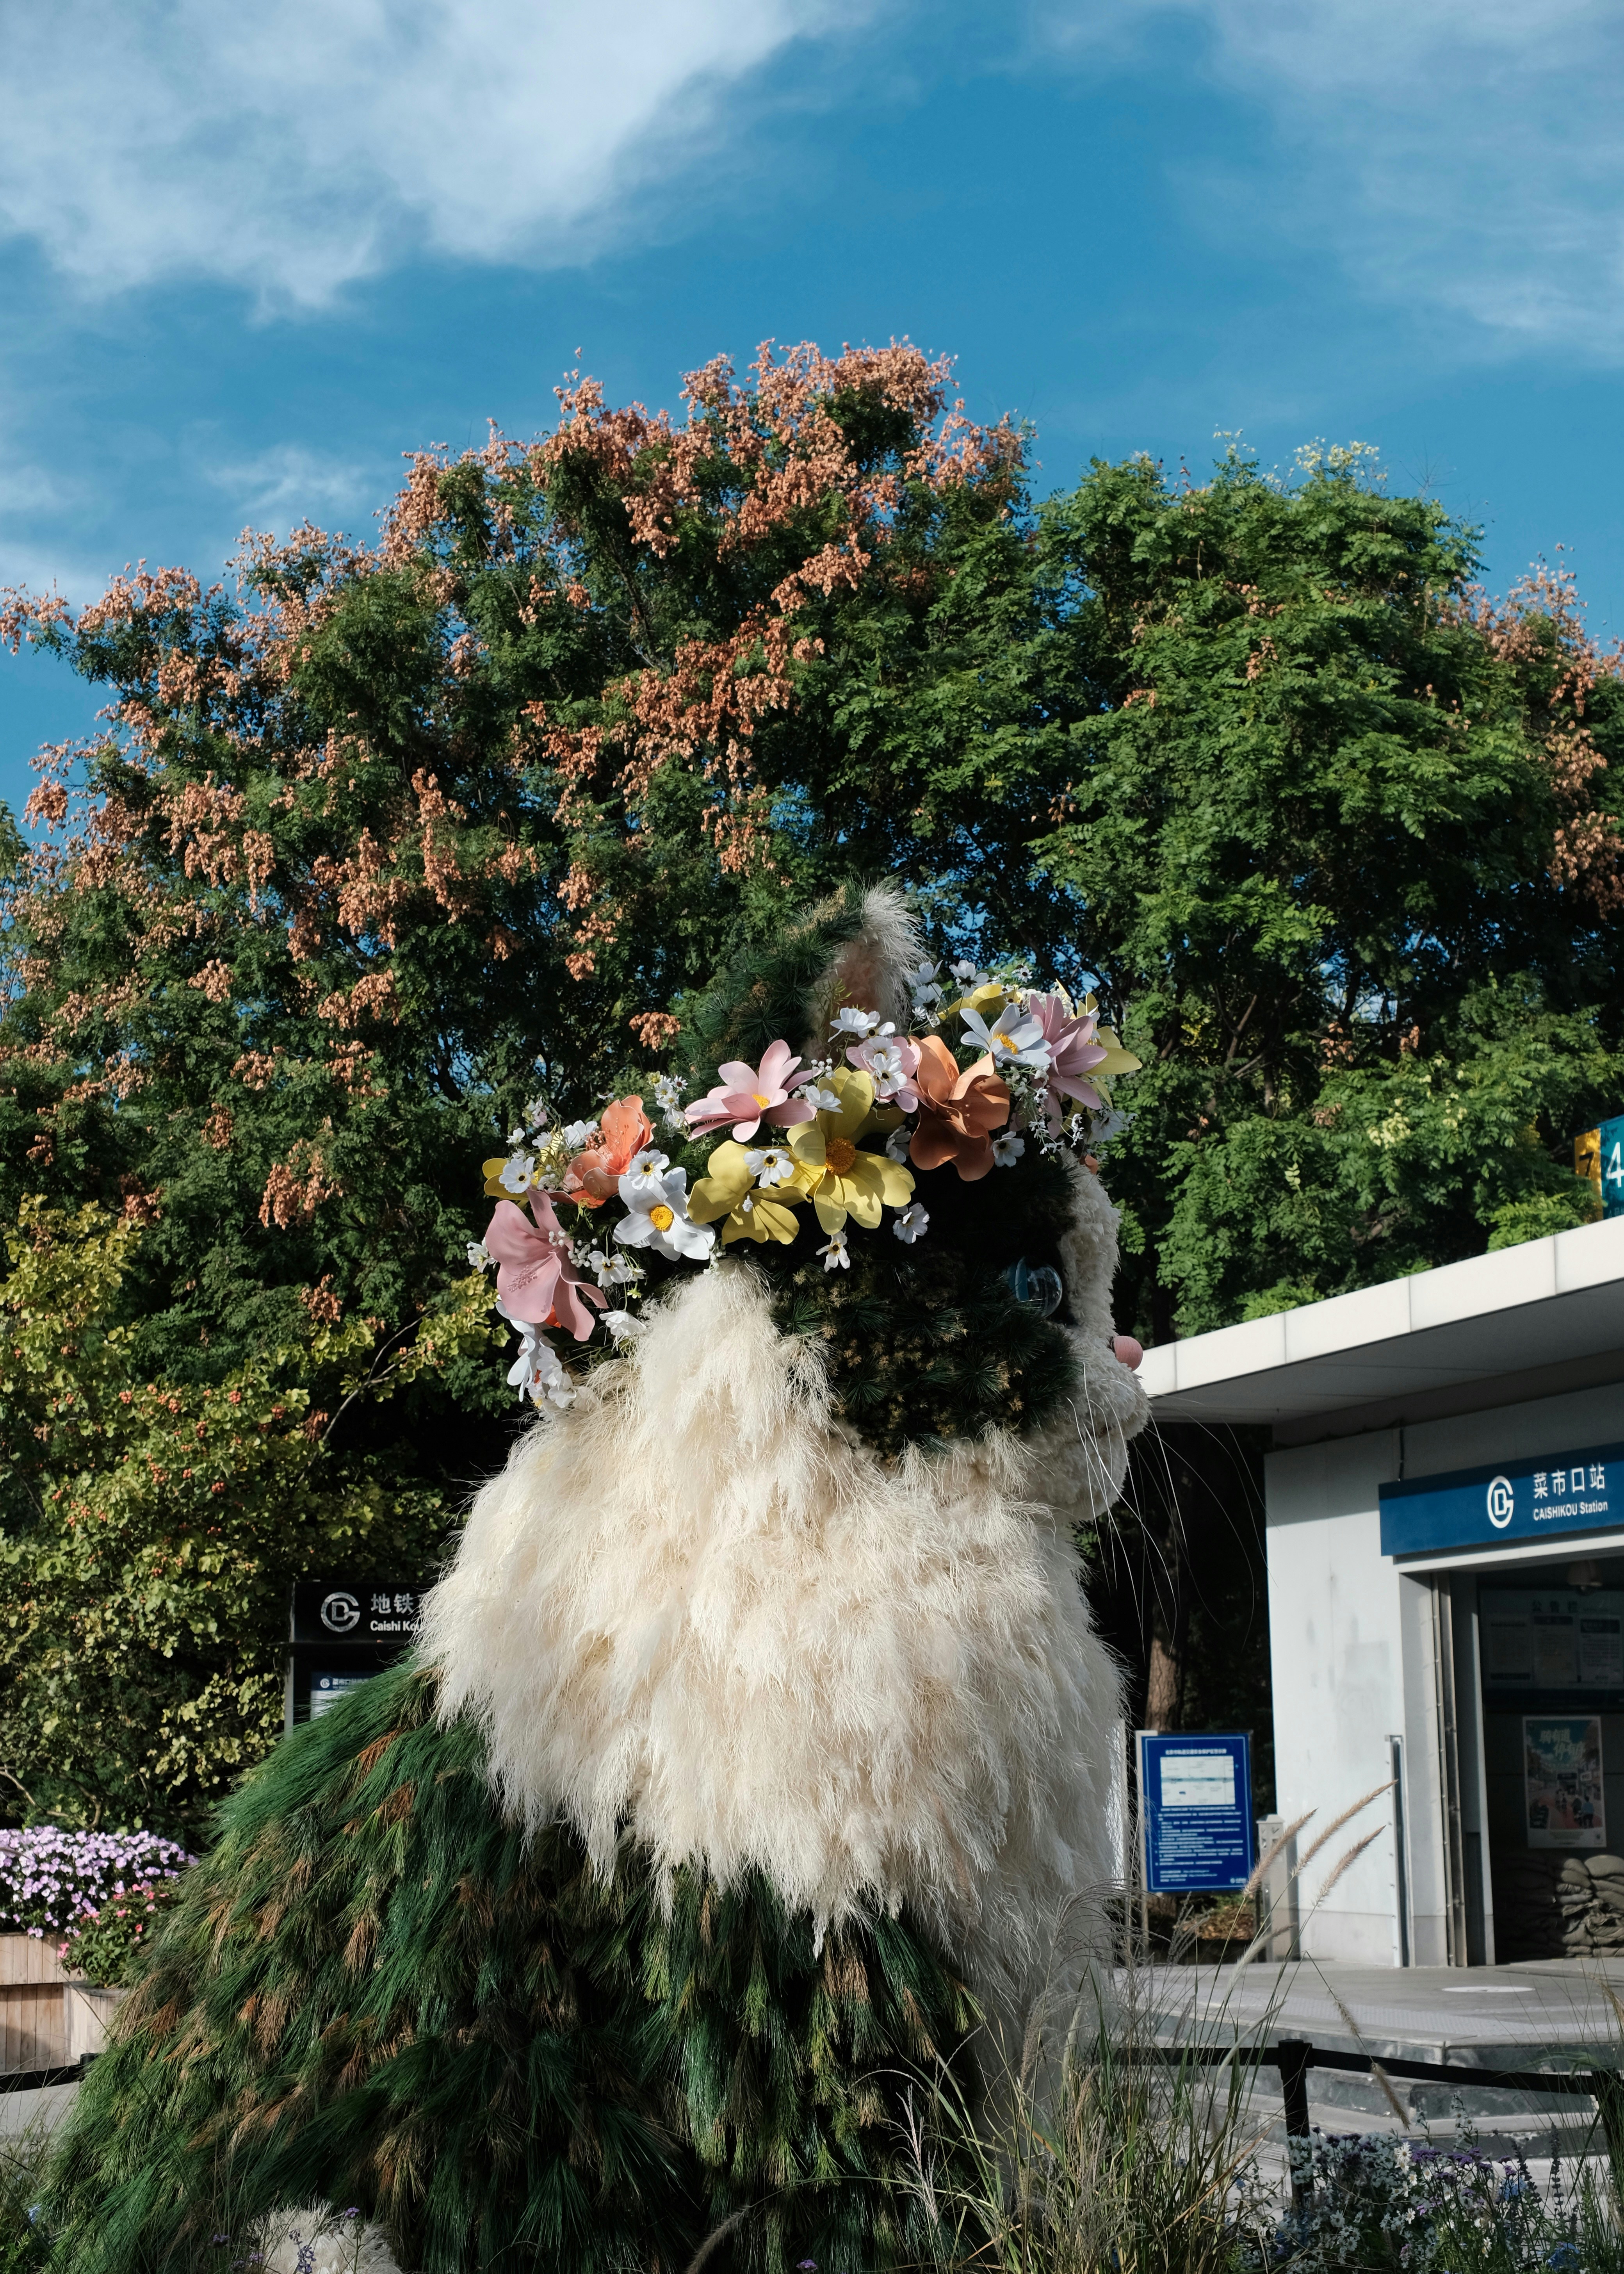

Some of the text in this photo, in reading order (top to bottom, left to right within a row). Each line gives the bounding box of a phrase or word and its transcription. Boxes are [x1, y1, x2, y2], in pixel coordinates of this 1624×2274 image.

[1606, 1142, 1624, 1188] 4
[1533, 1462, 1605, 1499] 菜市口站
[1534, 1500, 1608, 1521] CAISHIKOU Station
[370, 1620, 401, 1631] Caishi
